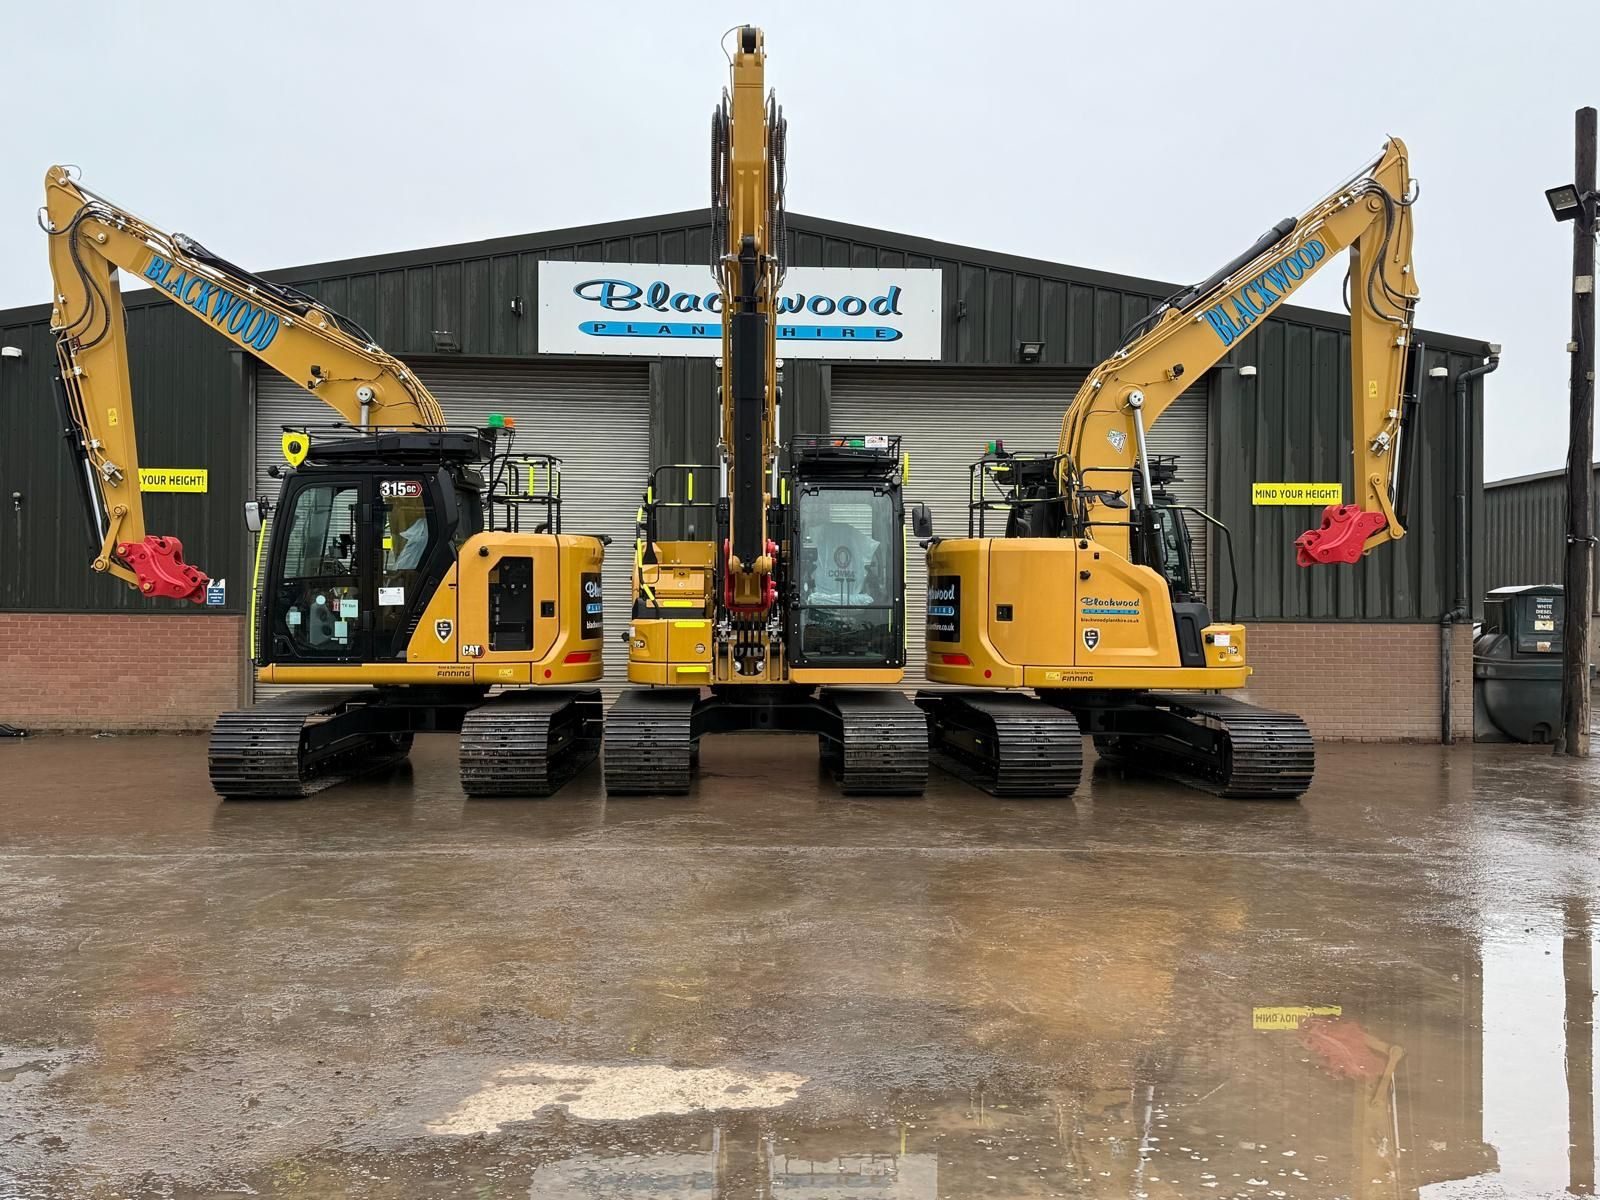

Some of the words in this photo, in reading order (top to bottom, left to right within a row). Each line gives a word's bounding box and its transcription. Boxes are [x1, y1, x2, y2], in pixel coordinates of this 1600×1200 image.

[572, 278, 904, 317] Blacwood
[1202, 239, 1326, 347] BLACKWOOD
[143, 254, 280, 352] BLACKWOOD
[593, 323, 705, 335] PLAN
[782, 327, 887, 338] HIRE
[142, 475, 166, 485] YOUR
[169, 475, 204, 486] HEIGHT!
[381, 481, 406, 496] 315
[1255, 489, 1277, 498] MIND
[1280, 489, 1303, 498] YOUR
[1305, 489, 1339, 498] HEIGHT!
[1080, 596, 1140, 607] Blackwood
[462, 645, 480, 656] CAT
